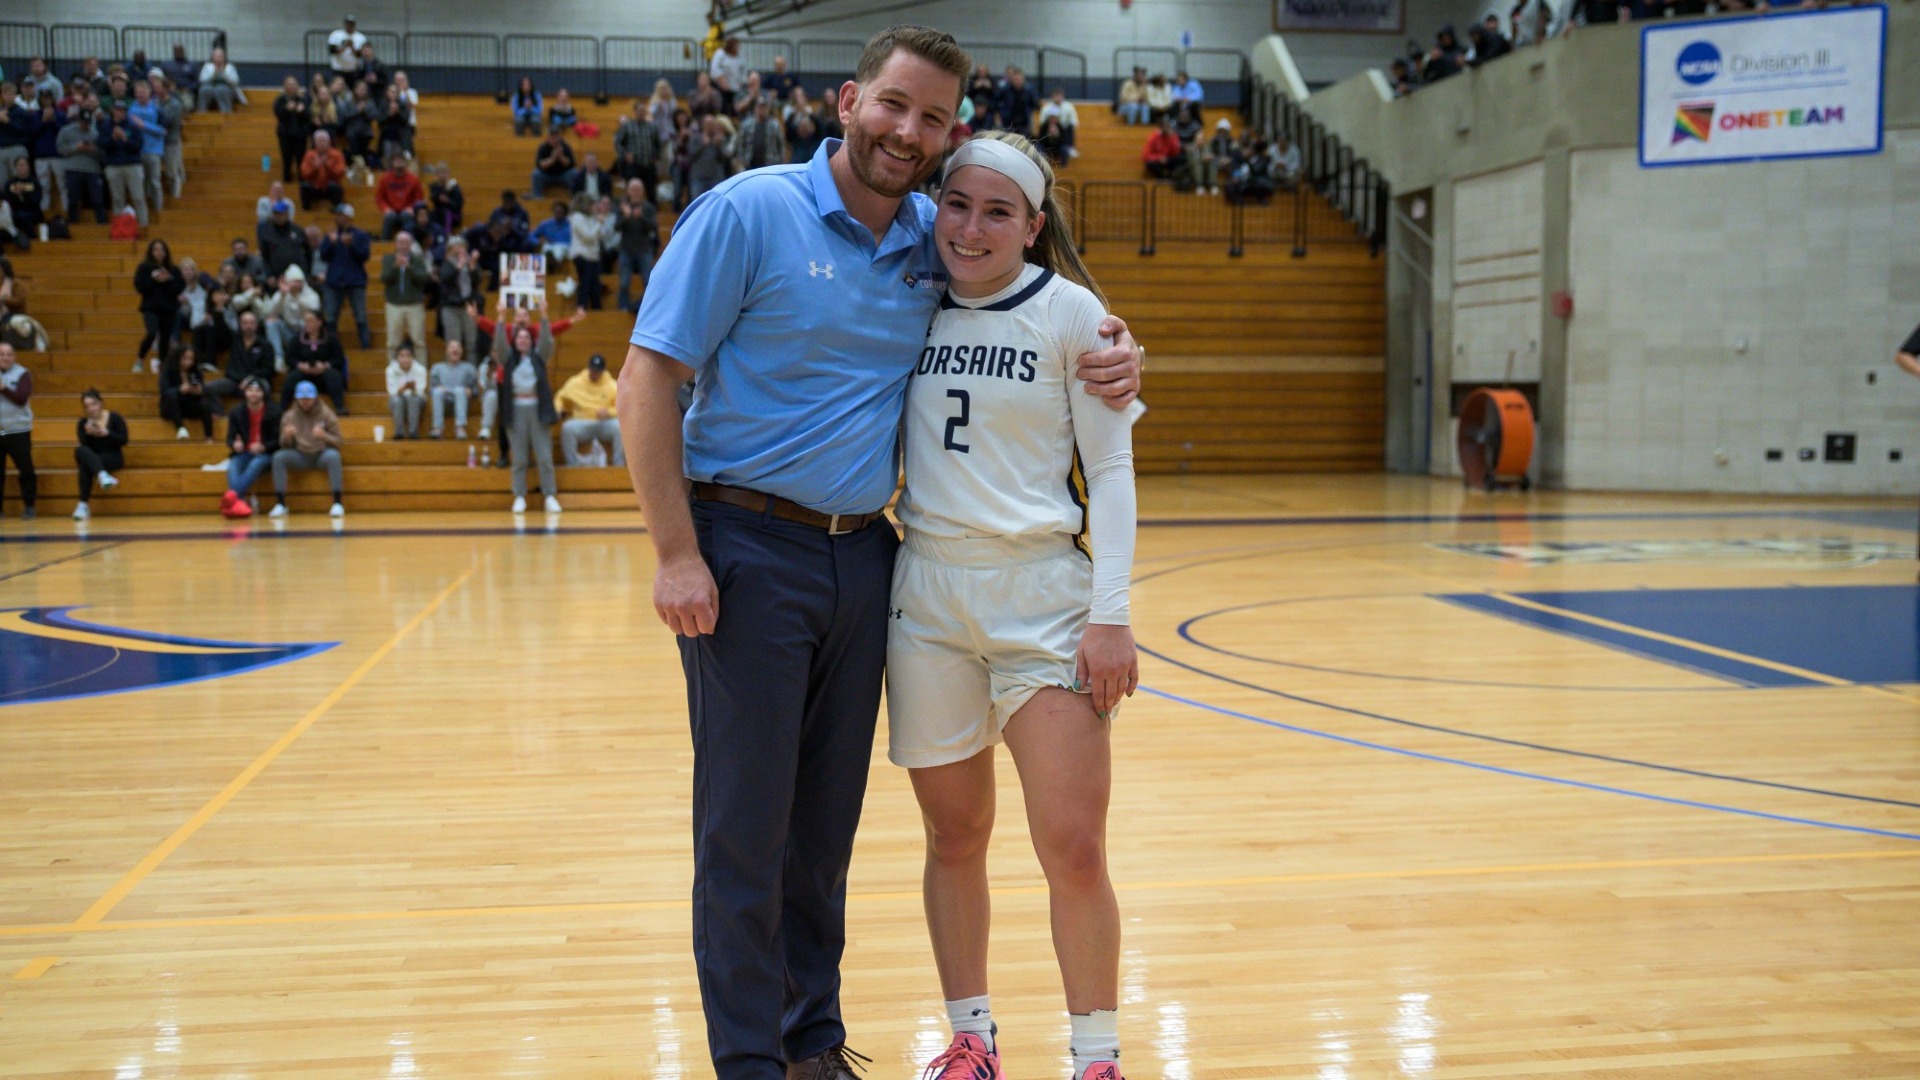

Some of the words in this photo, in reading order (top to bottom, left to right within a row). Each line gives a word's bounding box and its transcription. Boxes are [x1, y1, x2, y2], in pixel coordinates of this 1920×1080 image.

[1730, 52, 1809, 73] Division
[1814, 48, 1830, 66] III
[1719, 106, 1844, 130] ONETEAM
[908, 345, 1038, 383] ORSAIRS
[944, 389, 970, 454] 2
